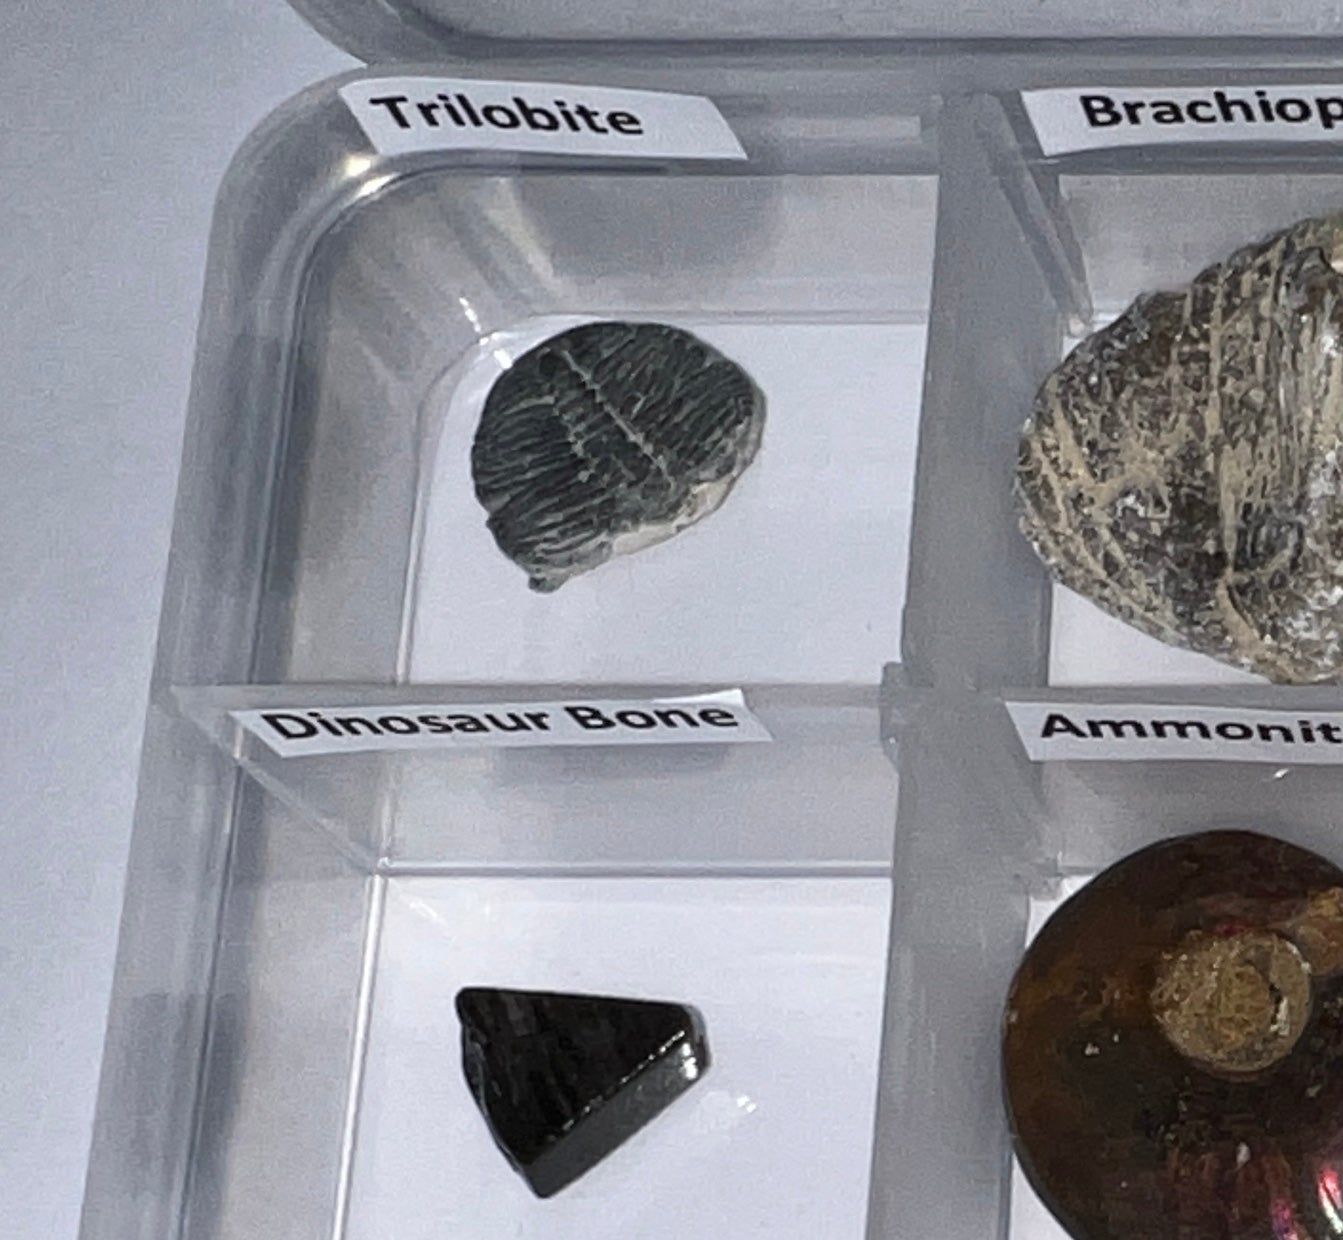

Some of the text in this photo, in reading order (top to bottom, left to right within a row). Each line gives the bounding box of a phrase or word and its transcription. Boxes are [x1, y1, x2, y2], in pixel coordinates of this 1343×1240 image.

[368, 93, 644, 135] Trilobite
[261, 704, 740, 741] Dinosaur Bone
